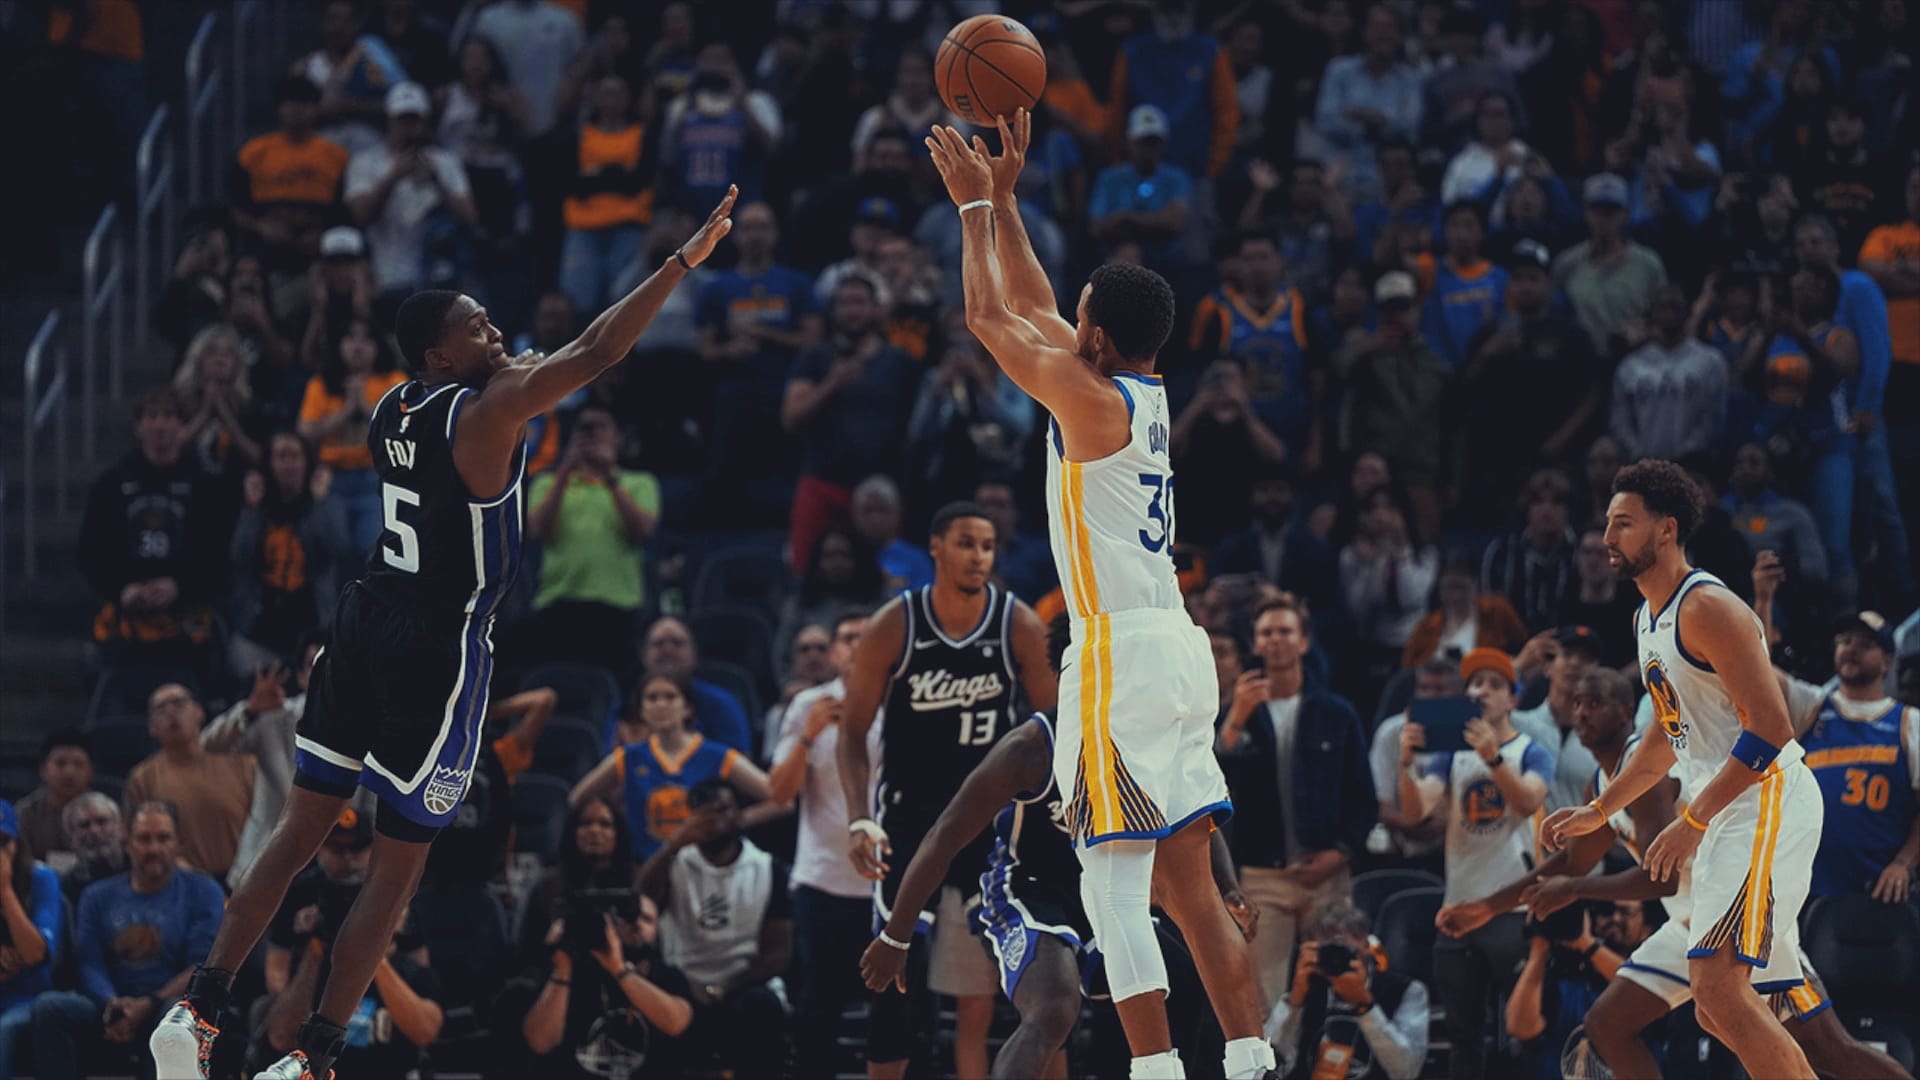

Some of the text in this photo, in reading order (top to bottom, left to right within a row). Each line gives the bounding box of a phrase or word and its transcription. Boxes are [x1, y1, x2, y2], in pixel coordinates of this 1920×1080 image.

[384, 438, 417, 470] FOX
[382, 482, 420, 574] 5
[908, 668, 1003, 711] Kings
[958, 709, 998, 746] 13
[1841, 767, 1890, 812] 30
